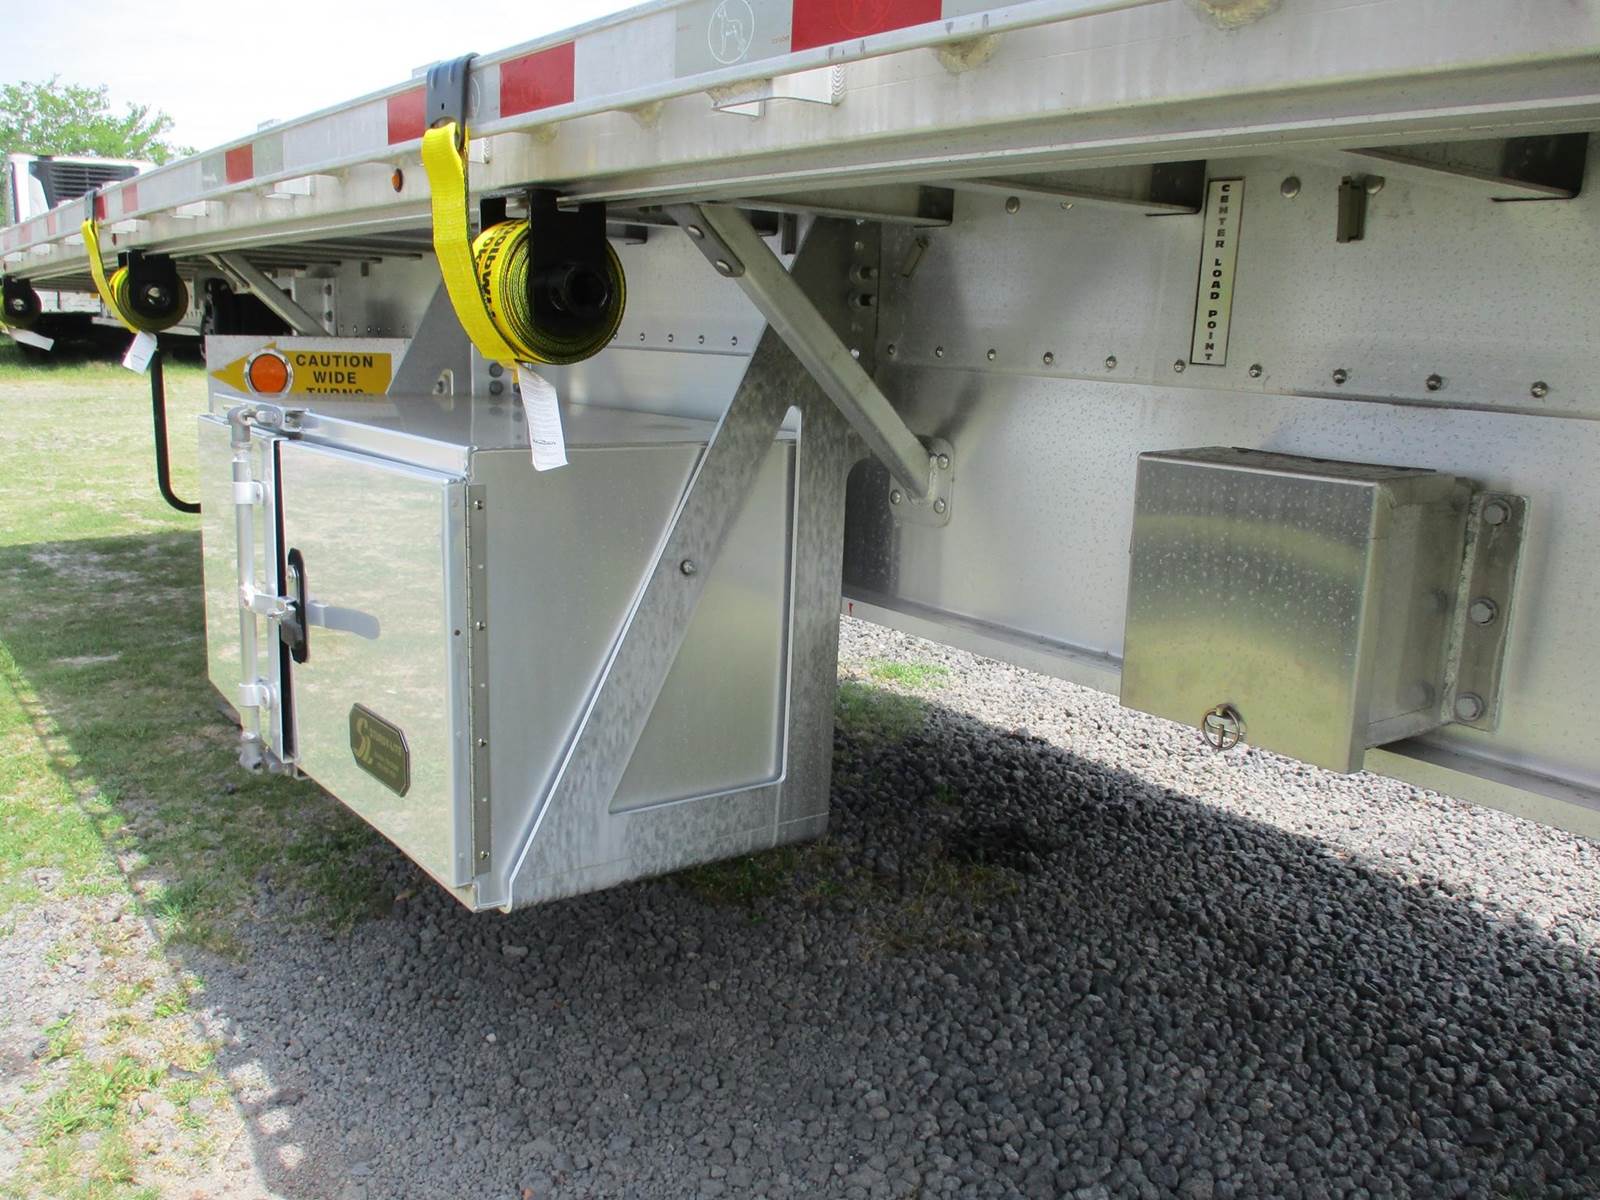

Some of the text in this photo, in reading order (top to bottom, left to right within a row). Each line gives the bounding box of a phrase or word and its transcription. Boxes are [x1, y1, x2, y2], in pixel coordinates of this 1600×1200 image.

[1205, 184, 1231, 361] CENTER LOAD POINT
[295, 354, 374, 368] CAUTION
[313, 371, 357, 385] WIDE
